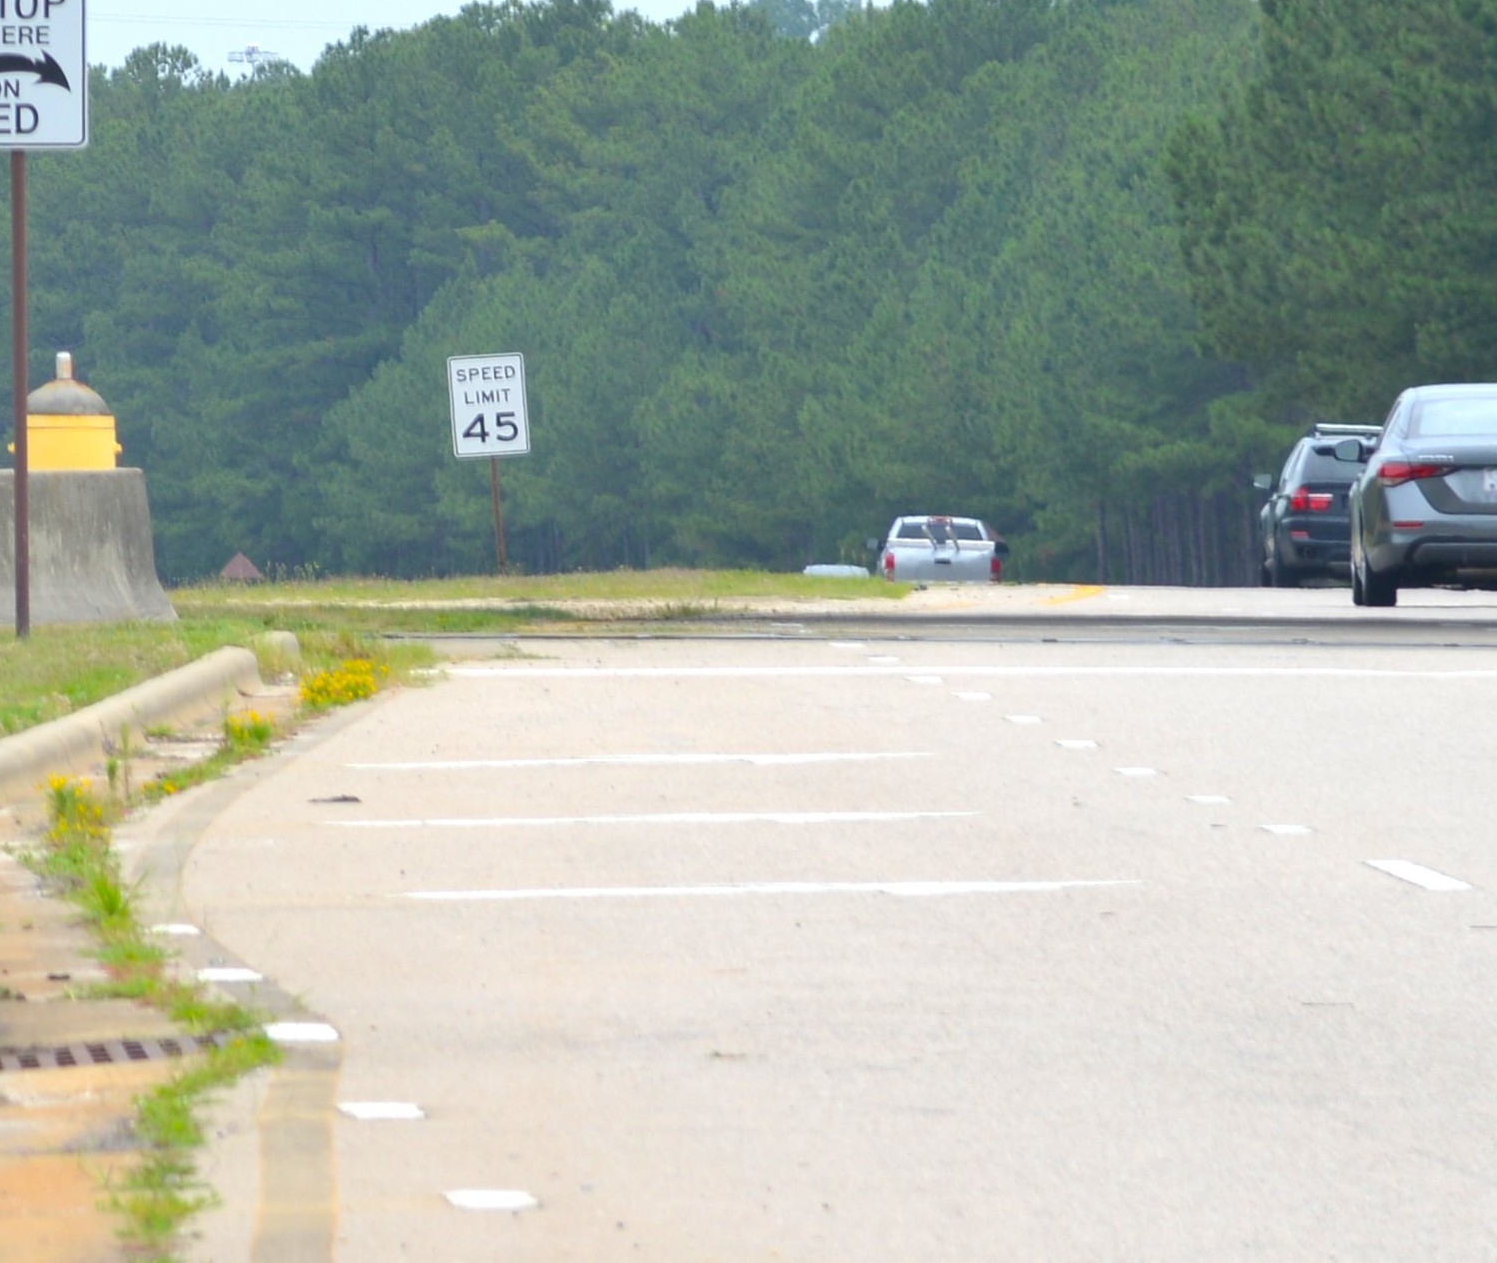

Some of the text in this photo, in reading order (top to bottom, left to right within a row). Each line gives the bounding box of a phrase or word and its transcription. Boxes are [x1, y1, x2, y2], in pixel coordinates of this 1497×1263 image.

[456, 365, 516, 382] SPEED
[464, 388, 511, 405] LIMIT
[462, 411, 519, 444] 45
